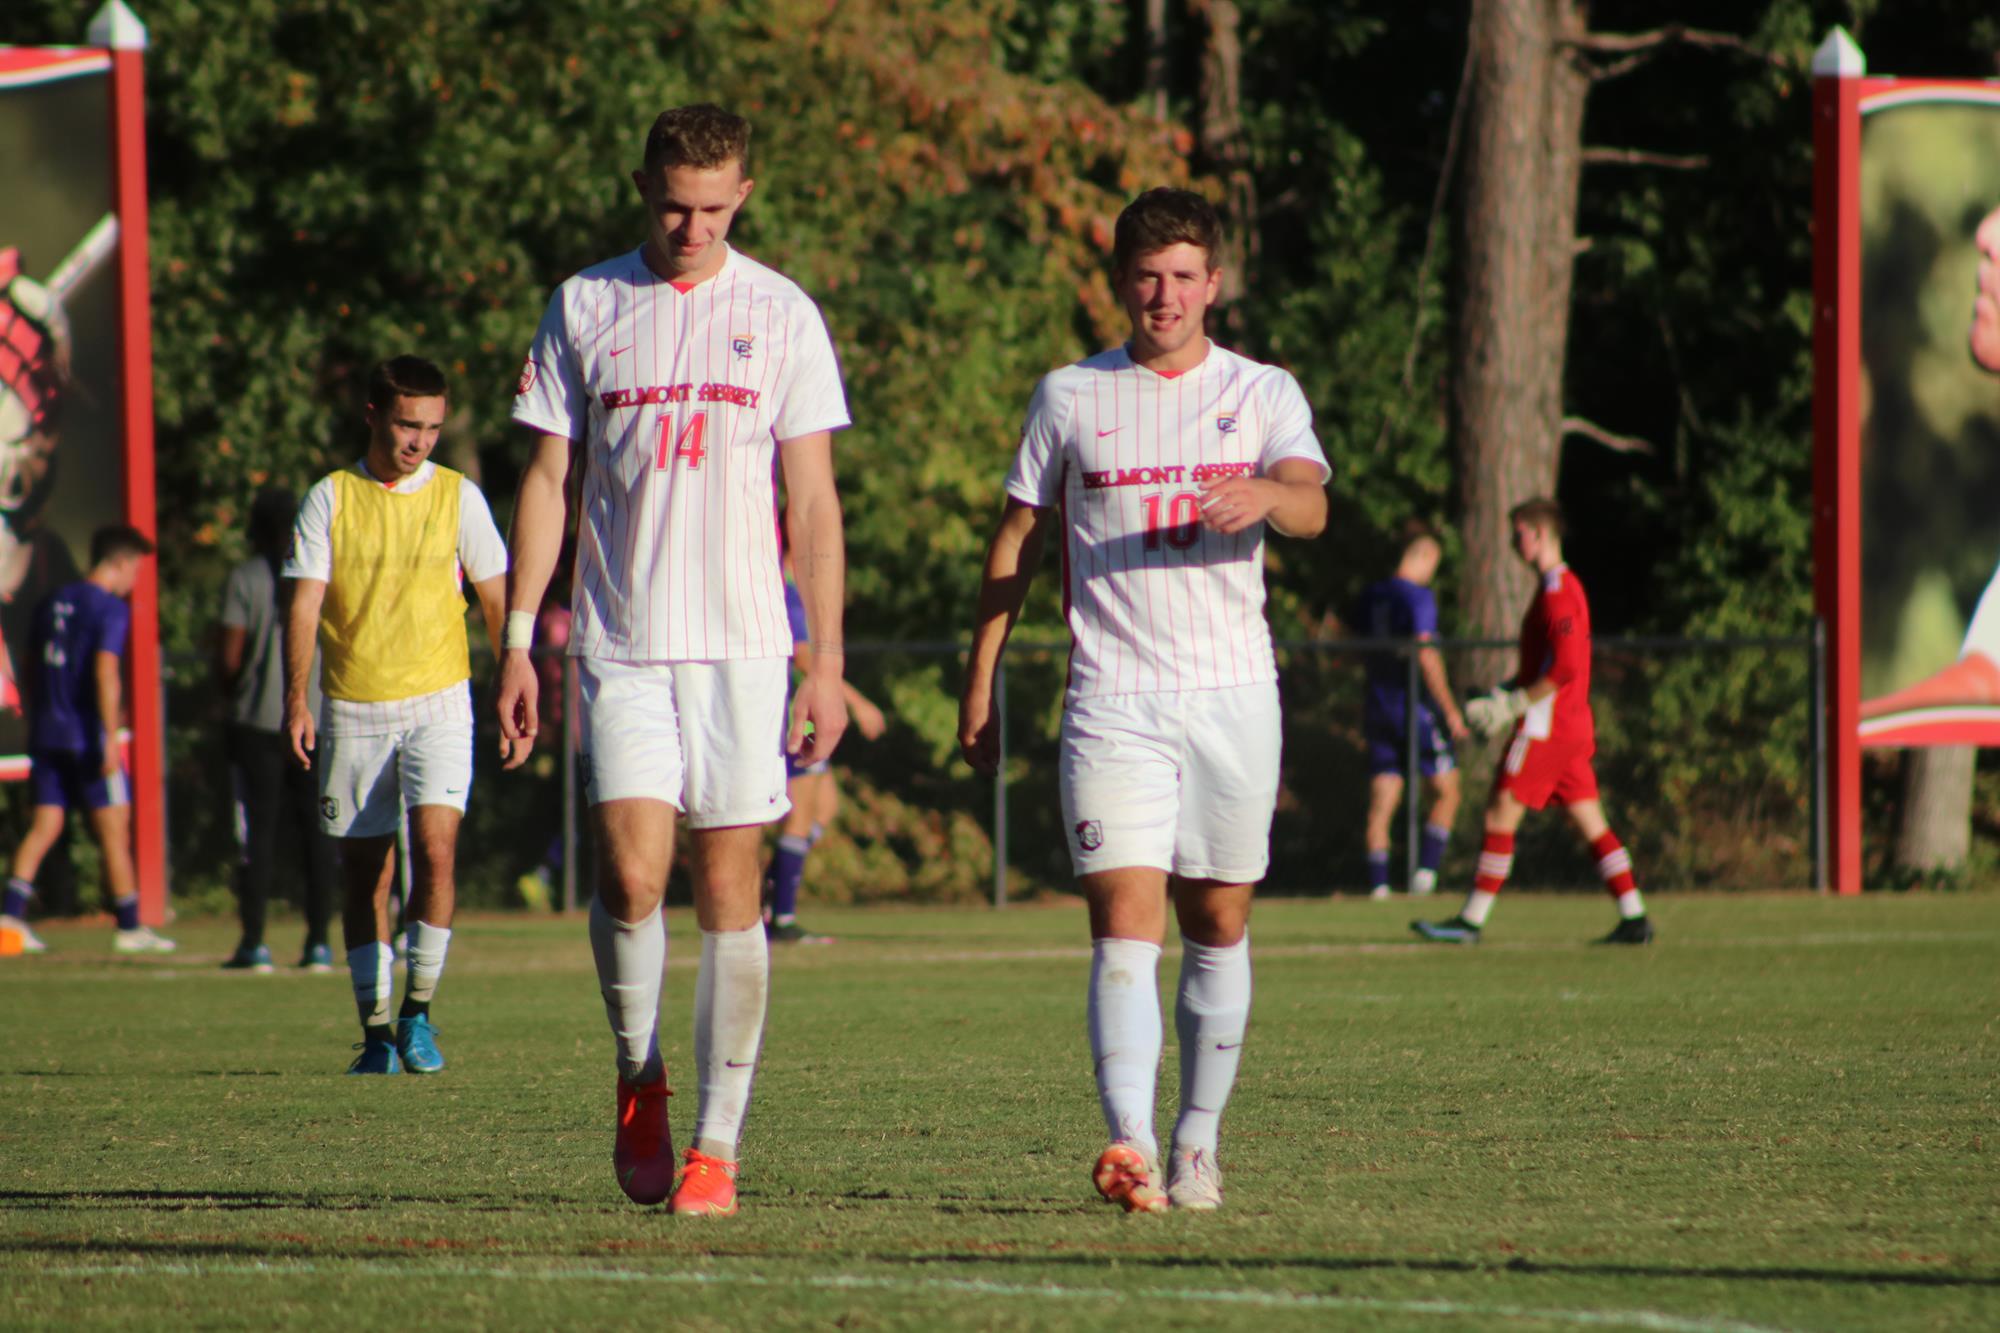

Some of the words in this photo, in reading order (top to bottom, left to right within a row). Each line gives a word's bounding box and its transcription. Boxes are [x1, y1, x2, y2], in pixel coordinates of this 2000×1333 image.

[600, 383, 693, 409] BELMONT
[698, 382, 760, 409] ABBEY
[655, 410, 708, 472] 14
[1082, 465, 1185, 489] BELMONT
[1140, 490, 1202, 552] 10
